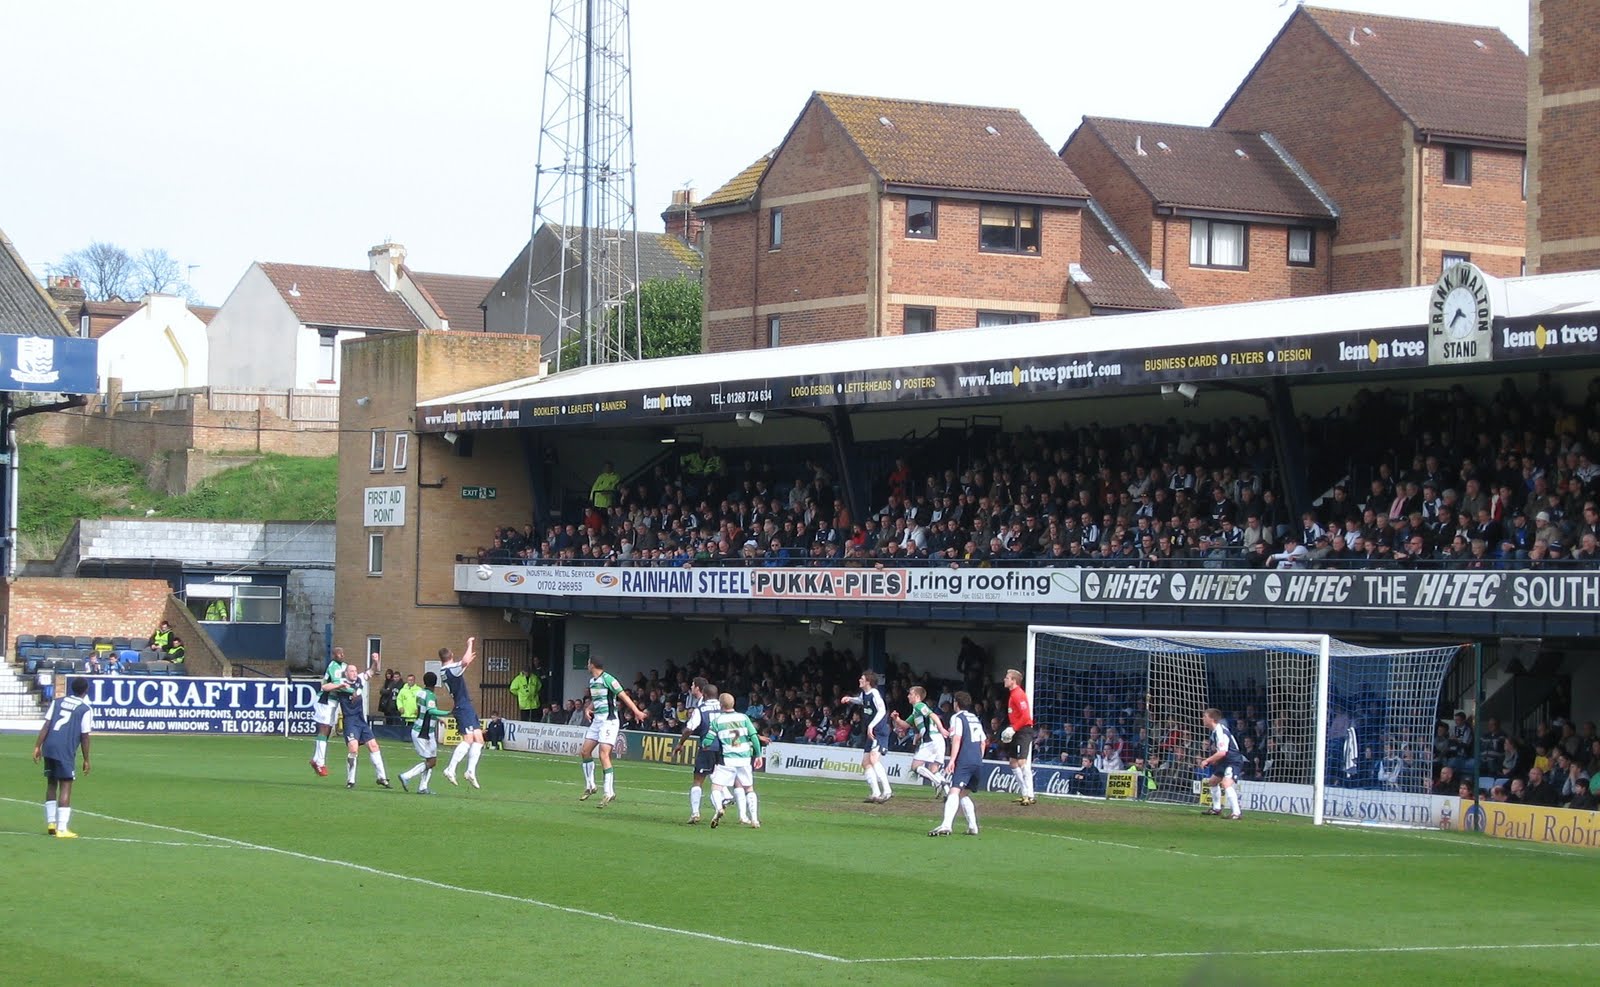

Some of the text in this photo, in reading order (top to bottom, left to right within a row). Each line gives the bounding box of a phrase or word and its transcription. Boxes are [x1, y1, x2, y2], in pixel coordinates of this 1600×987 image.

[1432, 268, 1489, 336] FRANK WALTON
[1560, 324, 1598, 344] tree
[1277, 348, 1312, 363] DESIGN
[1391, 339, 1425, 357] tree
[1443, 340, 1477, 359] STAND
[1144, 353, 1218, 372] BUSINESS CARDS
[1230, 351, 1264, 365] FLYERS
[791, 384, 835, 397] LOGO DESIGN
[844, 380, 892, 394] LETTERHEADS
[903, 377, 936, 389] POSTERS
[672, 394, 692, 408] tree
[727, 391, 746, 404] 01268
[747, 390, 759, 402] 724
[760, 389, 772, 401] 634
[533, 407, 560, 417] BOOKLETS
[567, 403, 593, 414] LEAFLETS
[601, 400, 627, 412] BANNERS
[367, 490, 401, 505] FIRST AID
[462, 489, 478, 497] EXIT
[373, 508, 394, 522] POINT
[622, 571, 749, 594] RAINHAM STEEL
[757, 571, 902, 596] PUKKA-PIES
[906, 571, 1051, 595] j.ring roofing
[1102, 573, 1161, 600] HI-TEC
[1188, 573, 1252, 601] HI-TEC
[1285, 575, 1352, 603] HI-TEC
[1363, 574, 1600, 607] THE HI-TEC SOUTH
[85, 680, 317, 708] LUCRAFT LTD
[53, 709, 72, 731] 7
[104, 708, 127, 717] YOUR
[129, 709, 177, 718] ALUMINIUM
[178, 709, 233, 719] SHOPFRONTS,
[235, 710, 267, 720] DOORS,
[107, 721, 145, 730] WALLING
[146, 721, 166, 730] AND
[167, 721, 210, 731] WINDOWS
[221, 721, 238, 732] TEL
[241, 721, 274, 733] 01268
[277, 721, 317, 733] 46535
[729, 730, 742, 747] 2
[1358, 801, 1397, 822] SONS
[1492, 810, 1535, 839] Paul
